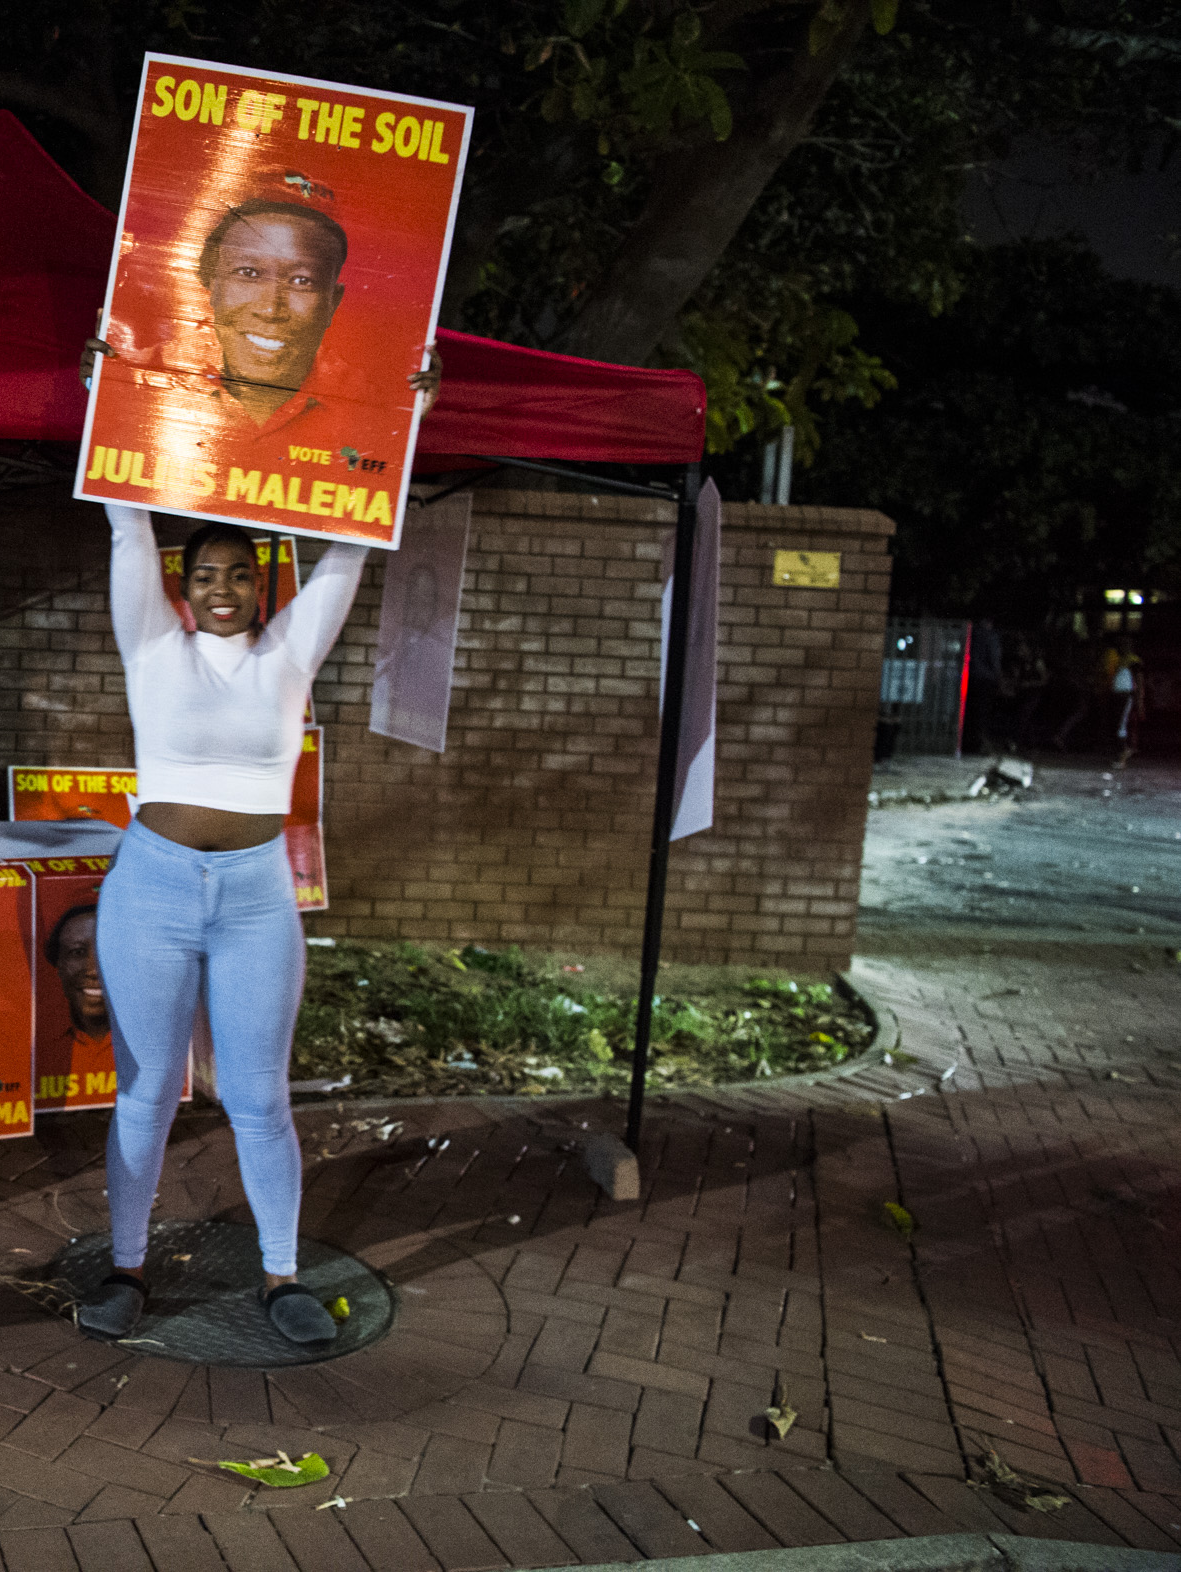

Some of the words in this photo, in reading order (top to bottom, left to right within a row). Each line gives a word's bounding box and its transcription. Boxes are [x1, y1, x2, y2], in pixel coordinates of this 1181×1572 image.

[151, 75, 228, 126] SON
[236, 89, 286, 134] OF
[297, 98, 365, 149] THE
[371, 112, 449, 164] SOIL
[87, 445, 218, 497] JULIUS
[226, 467, 393, 526] MALEMA
[288, 445, 332, 466] VOTE
[361, 458, 388, 473] EFF
[16, 774, 49, 793] SON
[52, 774, 73, 793] OF
[77, 775, 107, 794] THE
